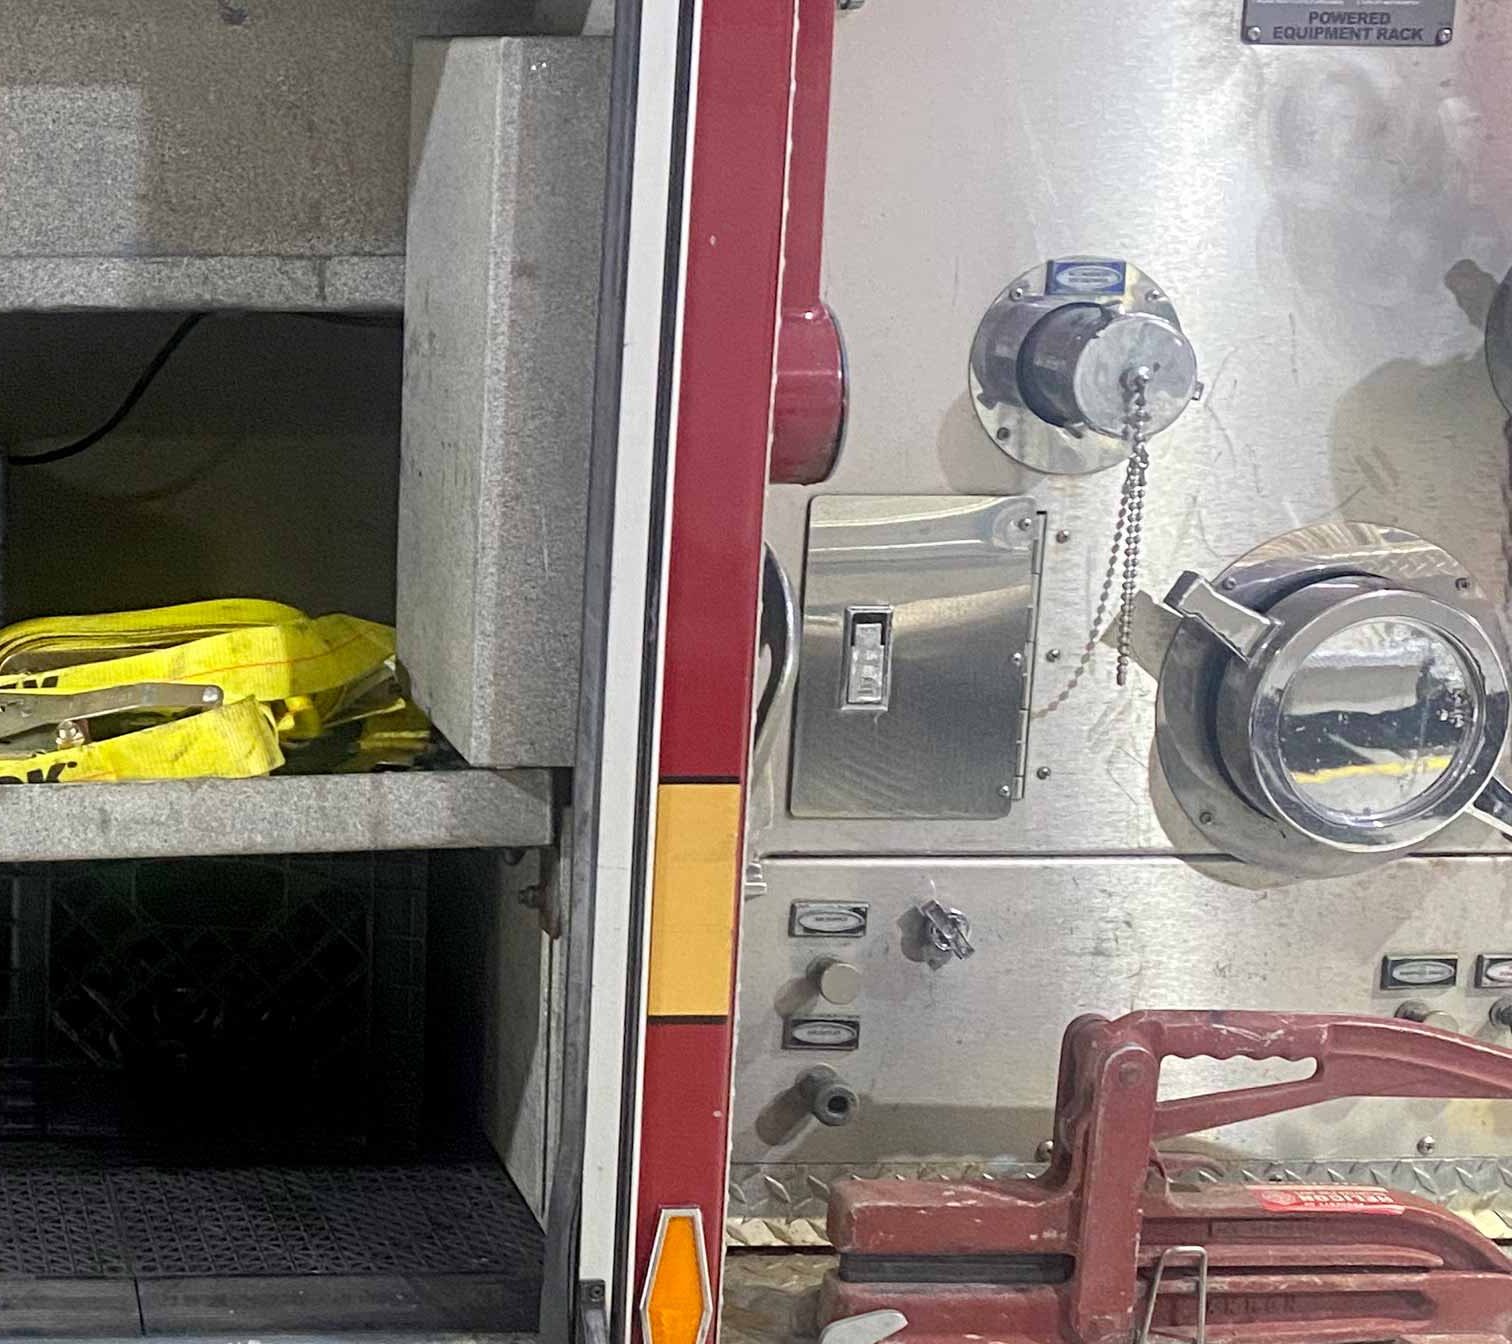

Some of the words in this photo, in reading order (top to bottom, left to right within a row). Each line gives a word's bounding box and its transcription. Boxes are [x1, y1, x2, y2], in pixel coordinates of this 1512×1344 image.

[1308, 11, 1391, 25] POWERED
[1272, 26, 1372, 41] EQUIPMENT
[1376, 27, 1425, 41] RACK
